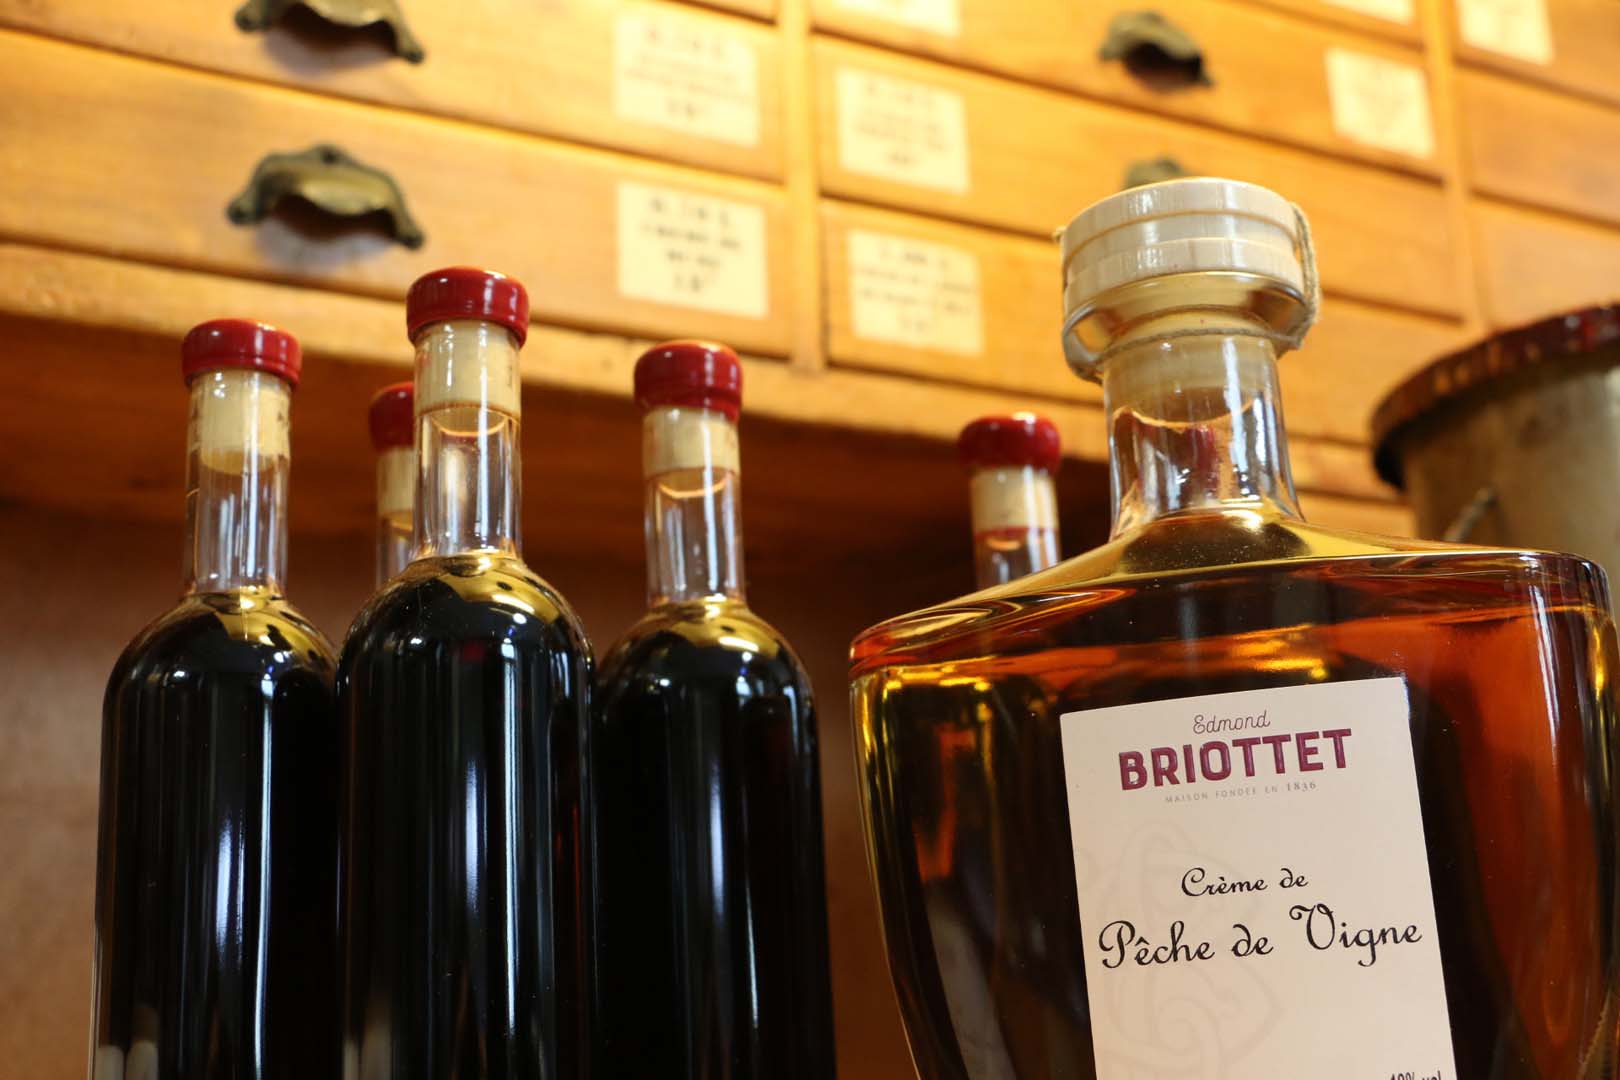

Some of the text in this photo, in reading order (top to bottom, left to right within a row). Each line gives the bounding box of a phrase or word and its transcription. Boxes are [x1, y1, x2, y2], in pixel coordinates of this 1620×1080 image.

[1192, 710, 1271, 735] Edmond
[1118, 729, 1352, 790] BRIOTTET
[1164, 792, 1209, 803] MAISON
[1264, 784, 1279, 794] EN
[1286, 781, 1317, 792] 1836
[1181, 867, 1308, 897] Crème de
[1099, 903, 1422, 968] Pêche de Vigne
